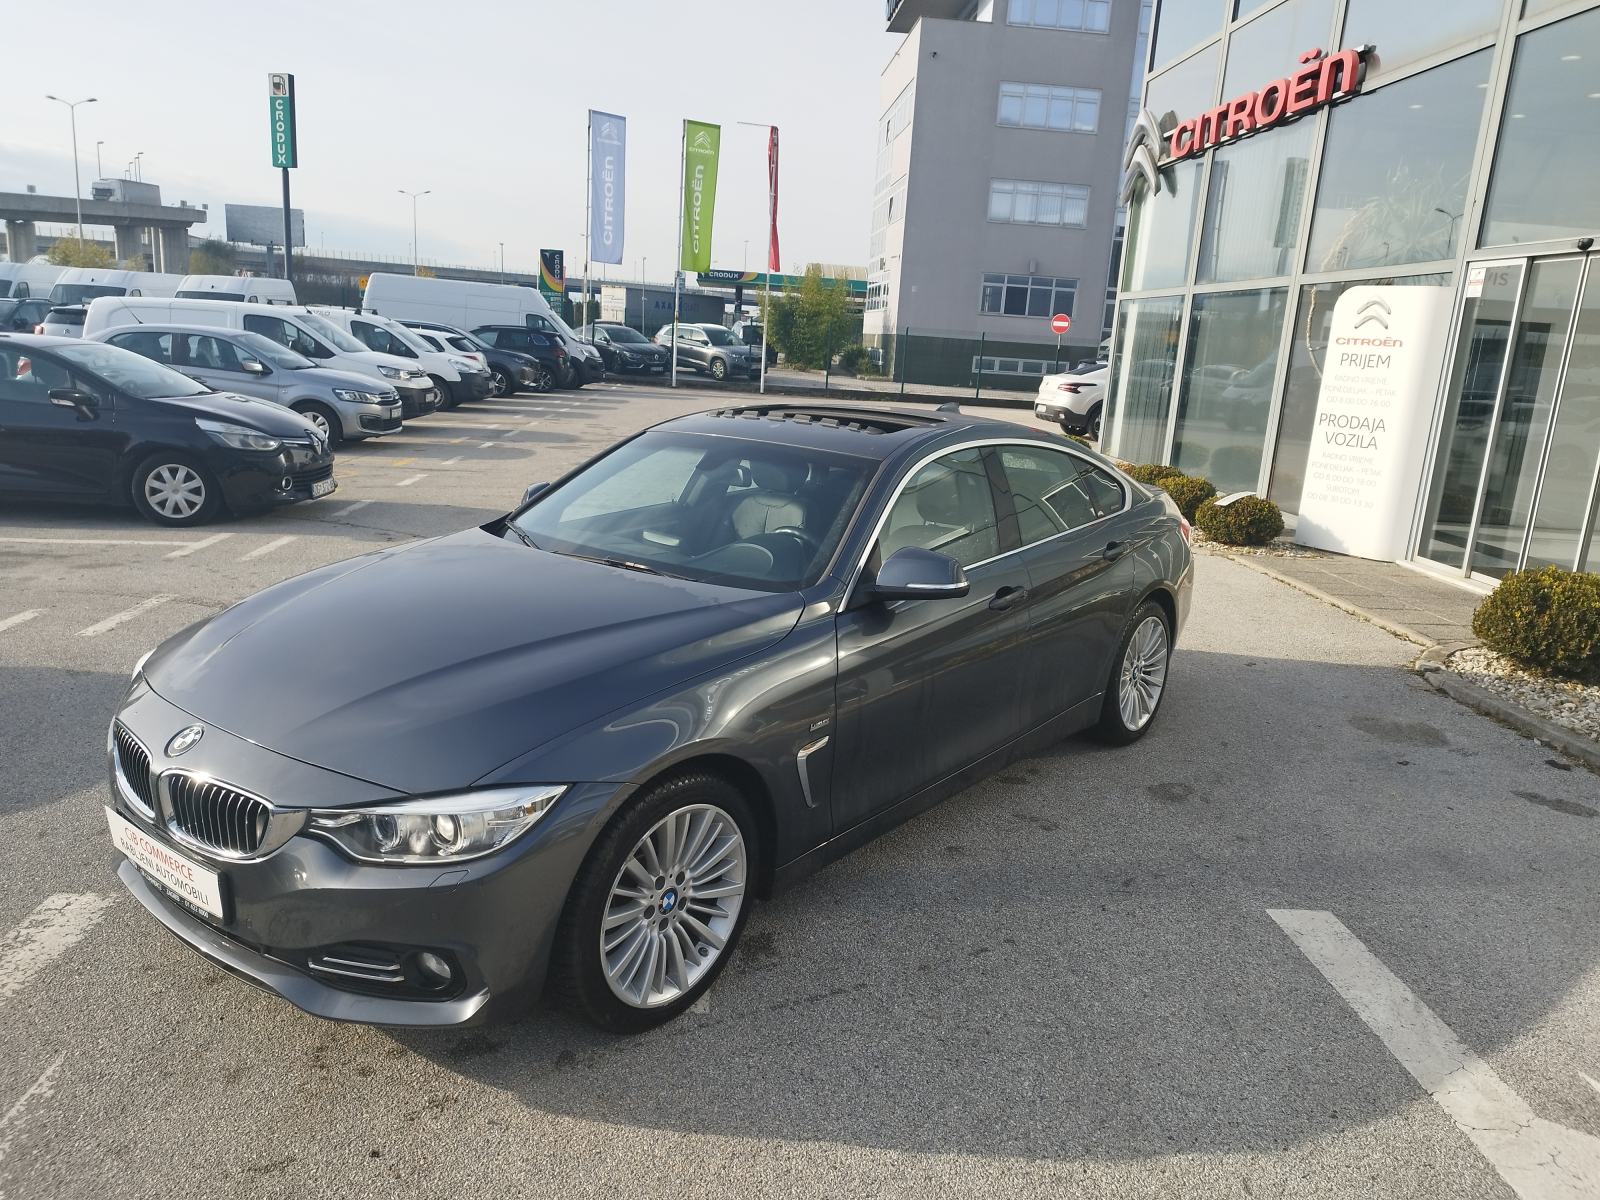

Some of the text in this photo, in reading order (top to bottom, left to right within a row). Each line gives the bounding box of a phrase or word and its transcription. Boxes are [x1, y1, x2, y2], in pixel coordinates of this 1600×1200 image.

[275, 99, 286, 164] CRODUX
[708, 271, 739, 279] CRODUX
[1339, 352, 1391, 370] PRIJEM
[1318, 413, 1386, 433] PRODAJA
[1325, 431, 1378, 450] VOZILA
[139, 837, 194, 882] COMMERCE
[155, 864, 210, 906] AUTOMOBILI
